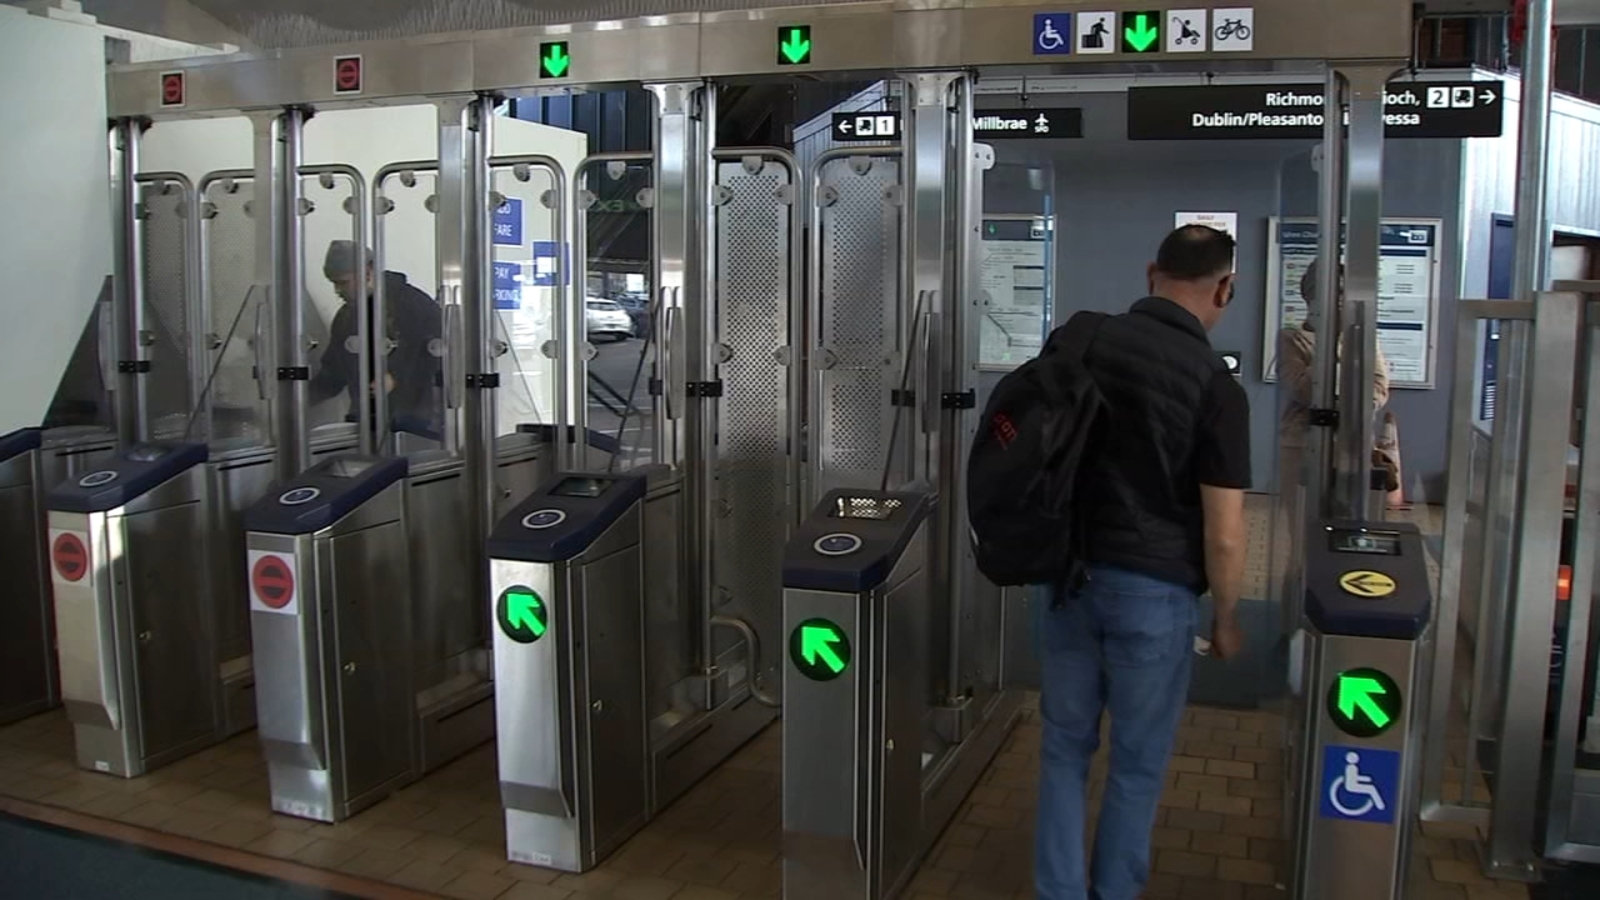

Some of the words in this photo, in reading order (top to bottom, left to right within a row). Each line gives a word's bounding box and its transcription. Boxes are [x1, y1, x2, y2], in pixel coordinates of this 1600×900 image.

[1266, 92, 1323, 106] Richmo
[1433, 90, 1444, 105] 2
[973, 115, 1028, 131] Millbrae
[1193, 112, 1324, 128] Dublin/Pleasanto
